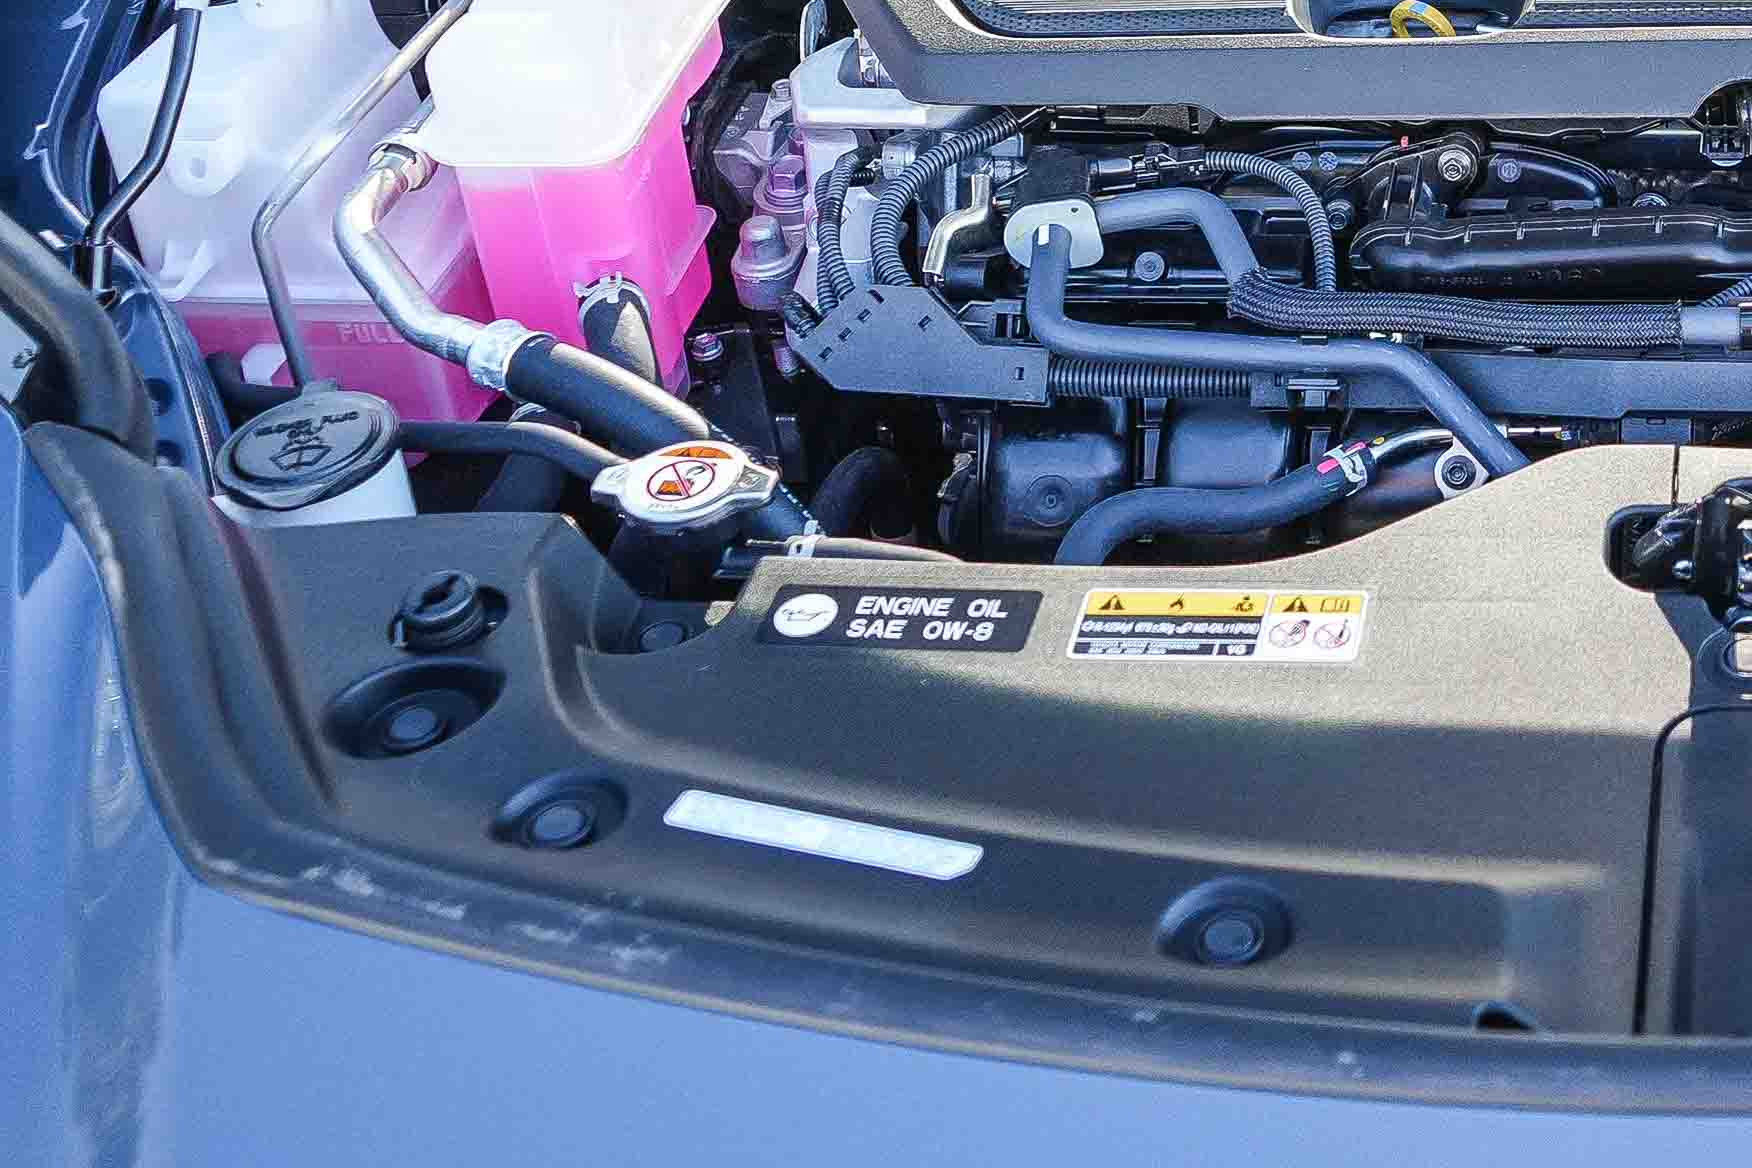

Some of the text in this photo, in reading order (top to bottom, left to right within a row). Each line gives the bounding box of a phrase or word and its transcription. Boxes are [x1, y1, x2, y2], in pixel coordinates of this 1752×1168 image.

[855, 595, 1009, 618] ENGINE OIL
[846, 618, 908, 640] SAE
